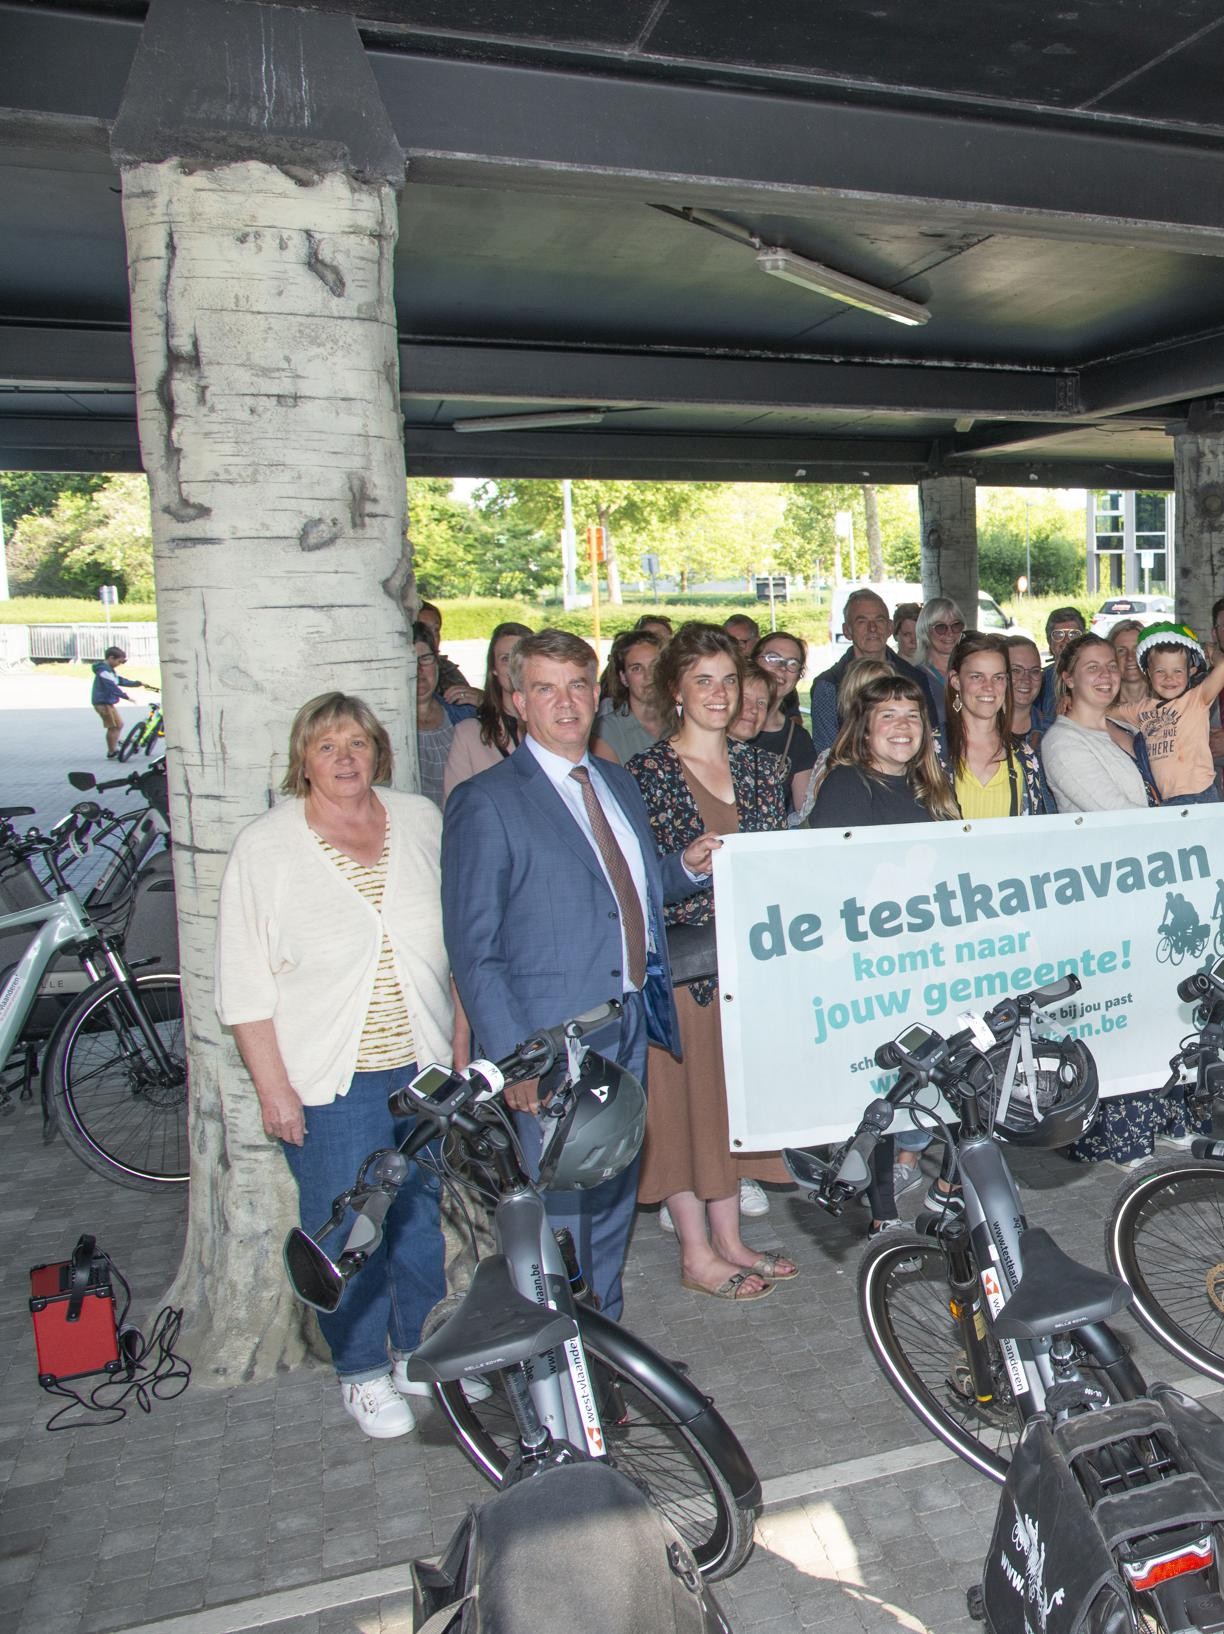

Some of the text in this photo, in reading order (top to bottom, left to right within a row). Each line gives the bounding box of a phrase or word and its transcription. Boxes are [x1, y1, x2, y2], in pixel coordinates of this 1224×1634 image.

[748, 843, 1211, 961] de testkaravaan
[813, 939, 1132, 1044] jouw gemeente!
[852, 928, 1031, 981] komt naar
[1060, 1004, 1077, 1020] bij
[1080, 1001, 1101, 1018] jou
[1105, 992, 1134, 1012] past
